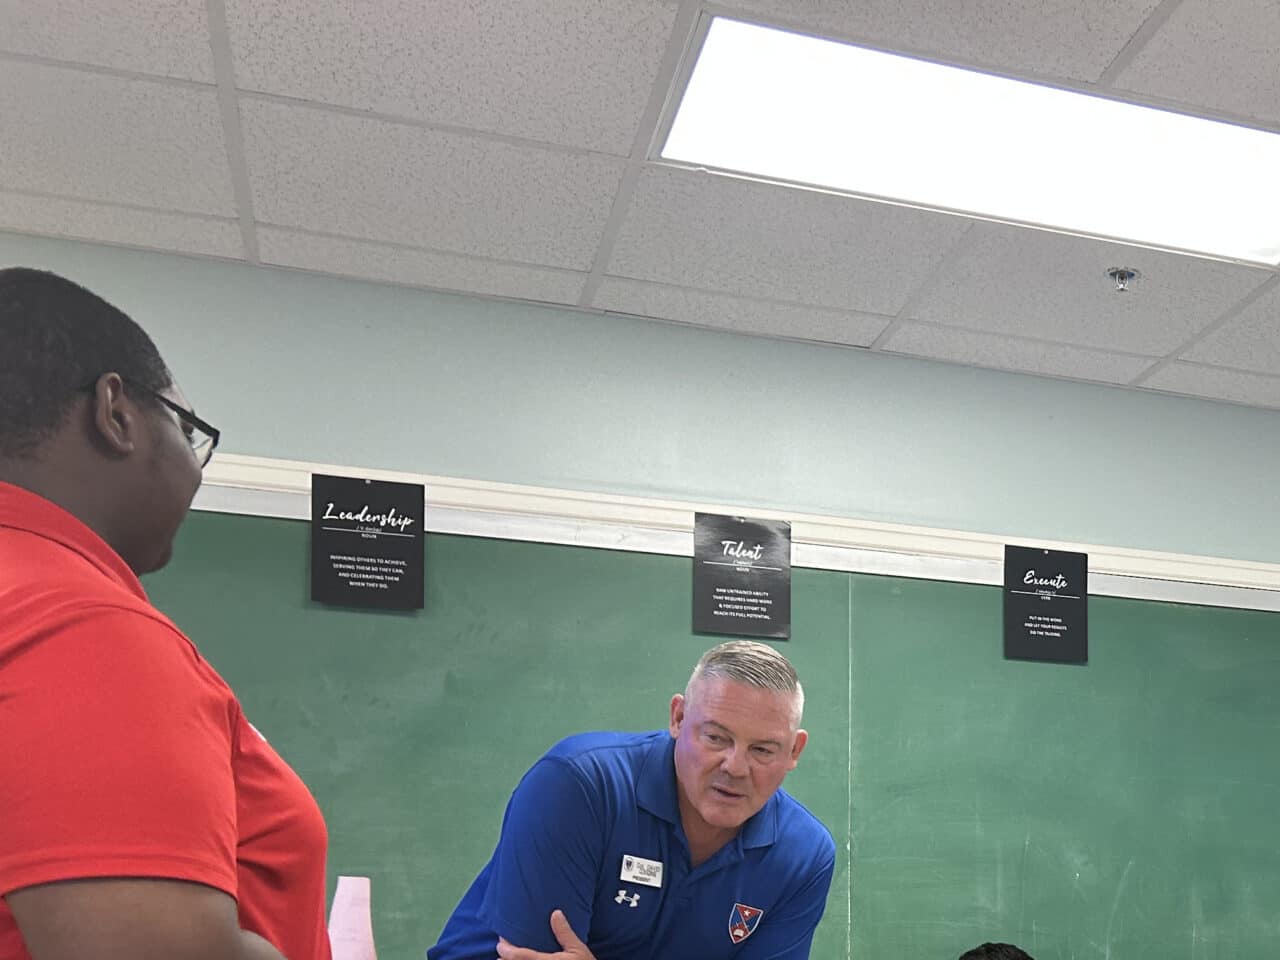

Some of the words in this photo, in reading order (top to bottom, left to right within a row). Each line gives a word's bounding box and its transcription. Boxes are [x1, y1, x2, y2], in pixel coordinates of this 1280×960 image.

[321, 502, 415, 532] Leadership
[721, 541, 765, 560] Talent
[1023, 570, 1068, 589] Execute
